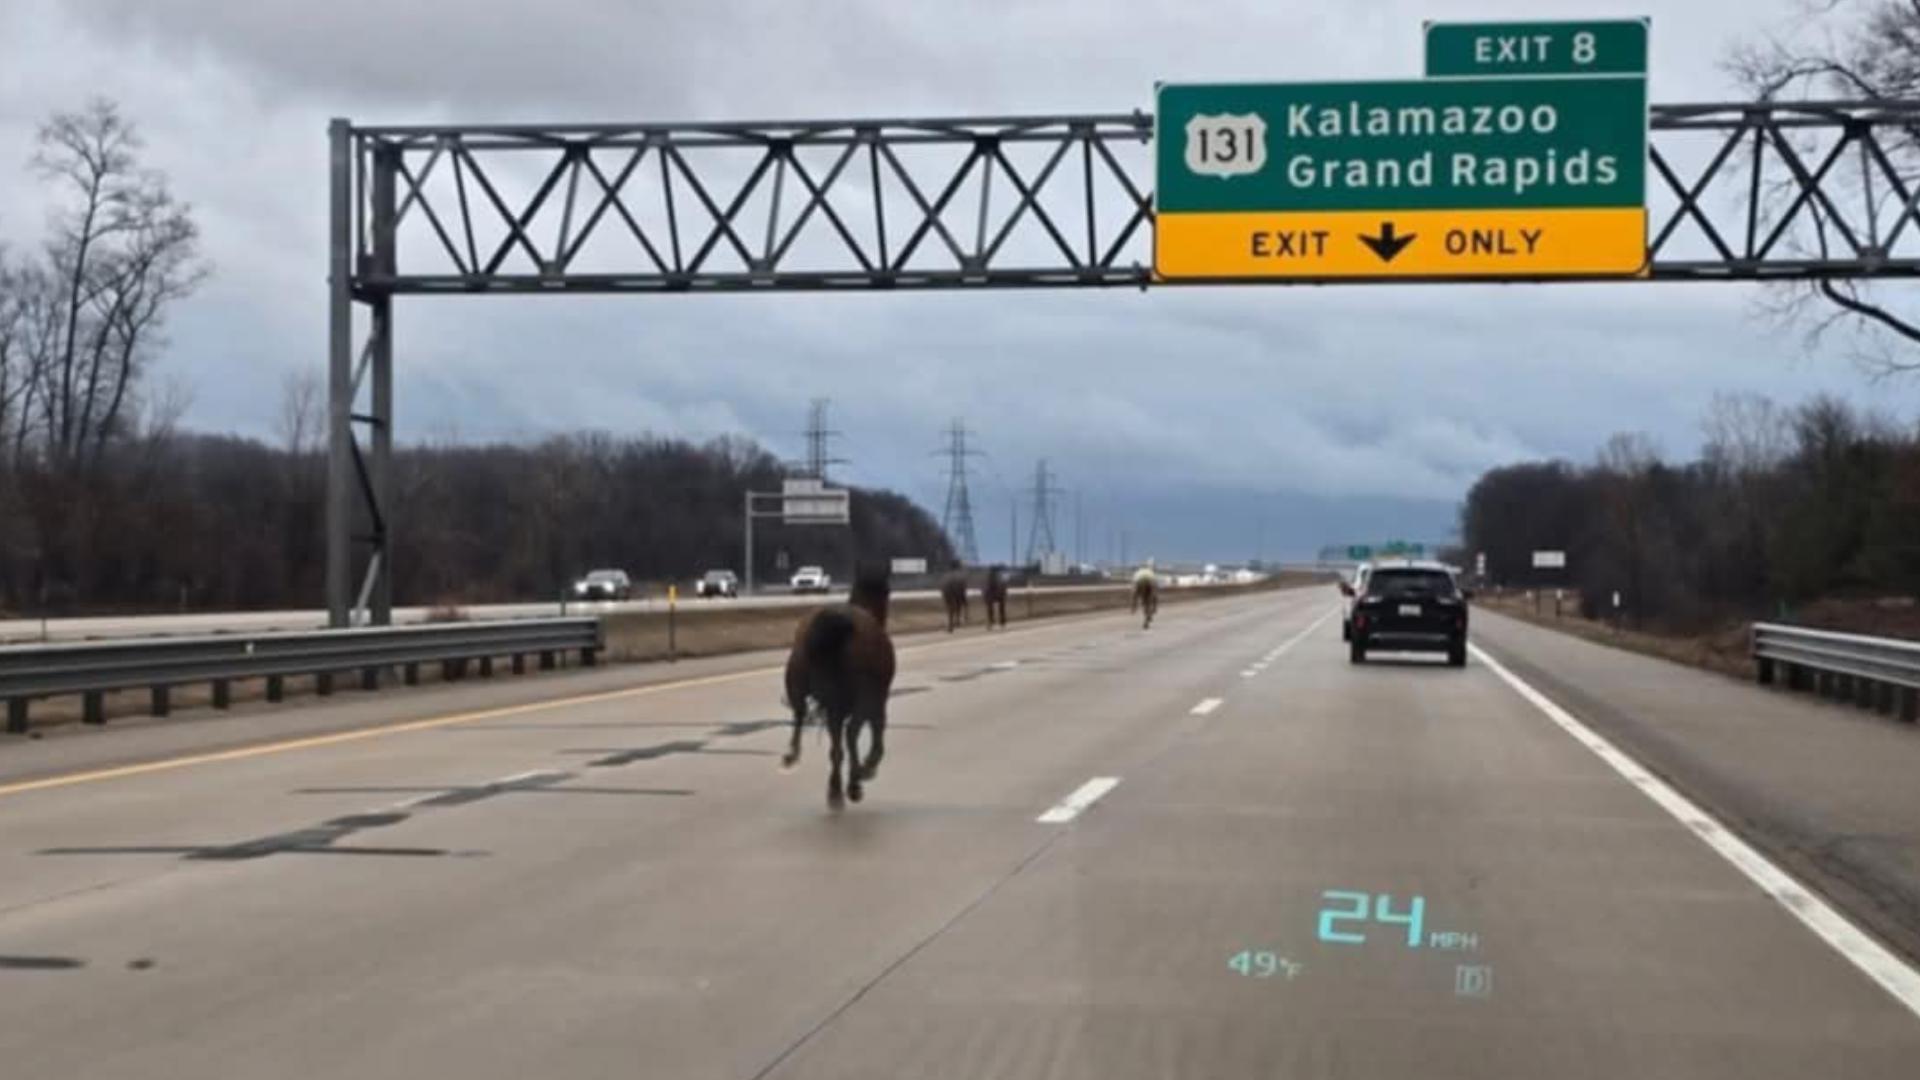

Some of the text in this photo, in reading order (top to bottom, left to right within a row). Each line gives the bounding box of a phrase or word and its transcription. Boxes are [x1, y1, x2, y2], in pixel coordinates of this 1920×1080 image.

[1475, 32, 1596, 64] EXIT 8
[1288, 102, 1558, 137] Kalamazoo
[1199, 127, 1255, 163] 131
[1288, 149, 1618, 194] Grand Rapids
[1251, 229, 1543, 257] EXIT ONLY
[1318, 889, 1478, 948] 24 MPH
